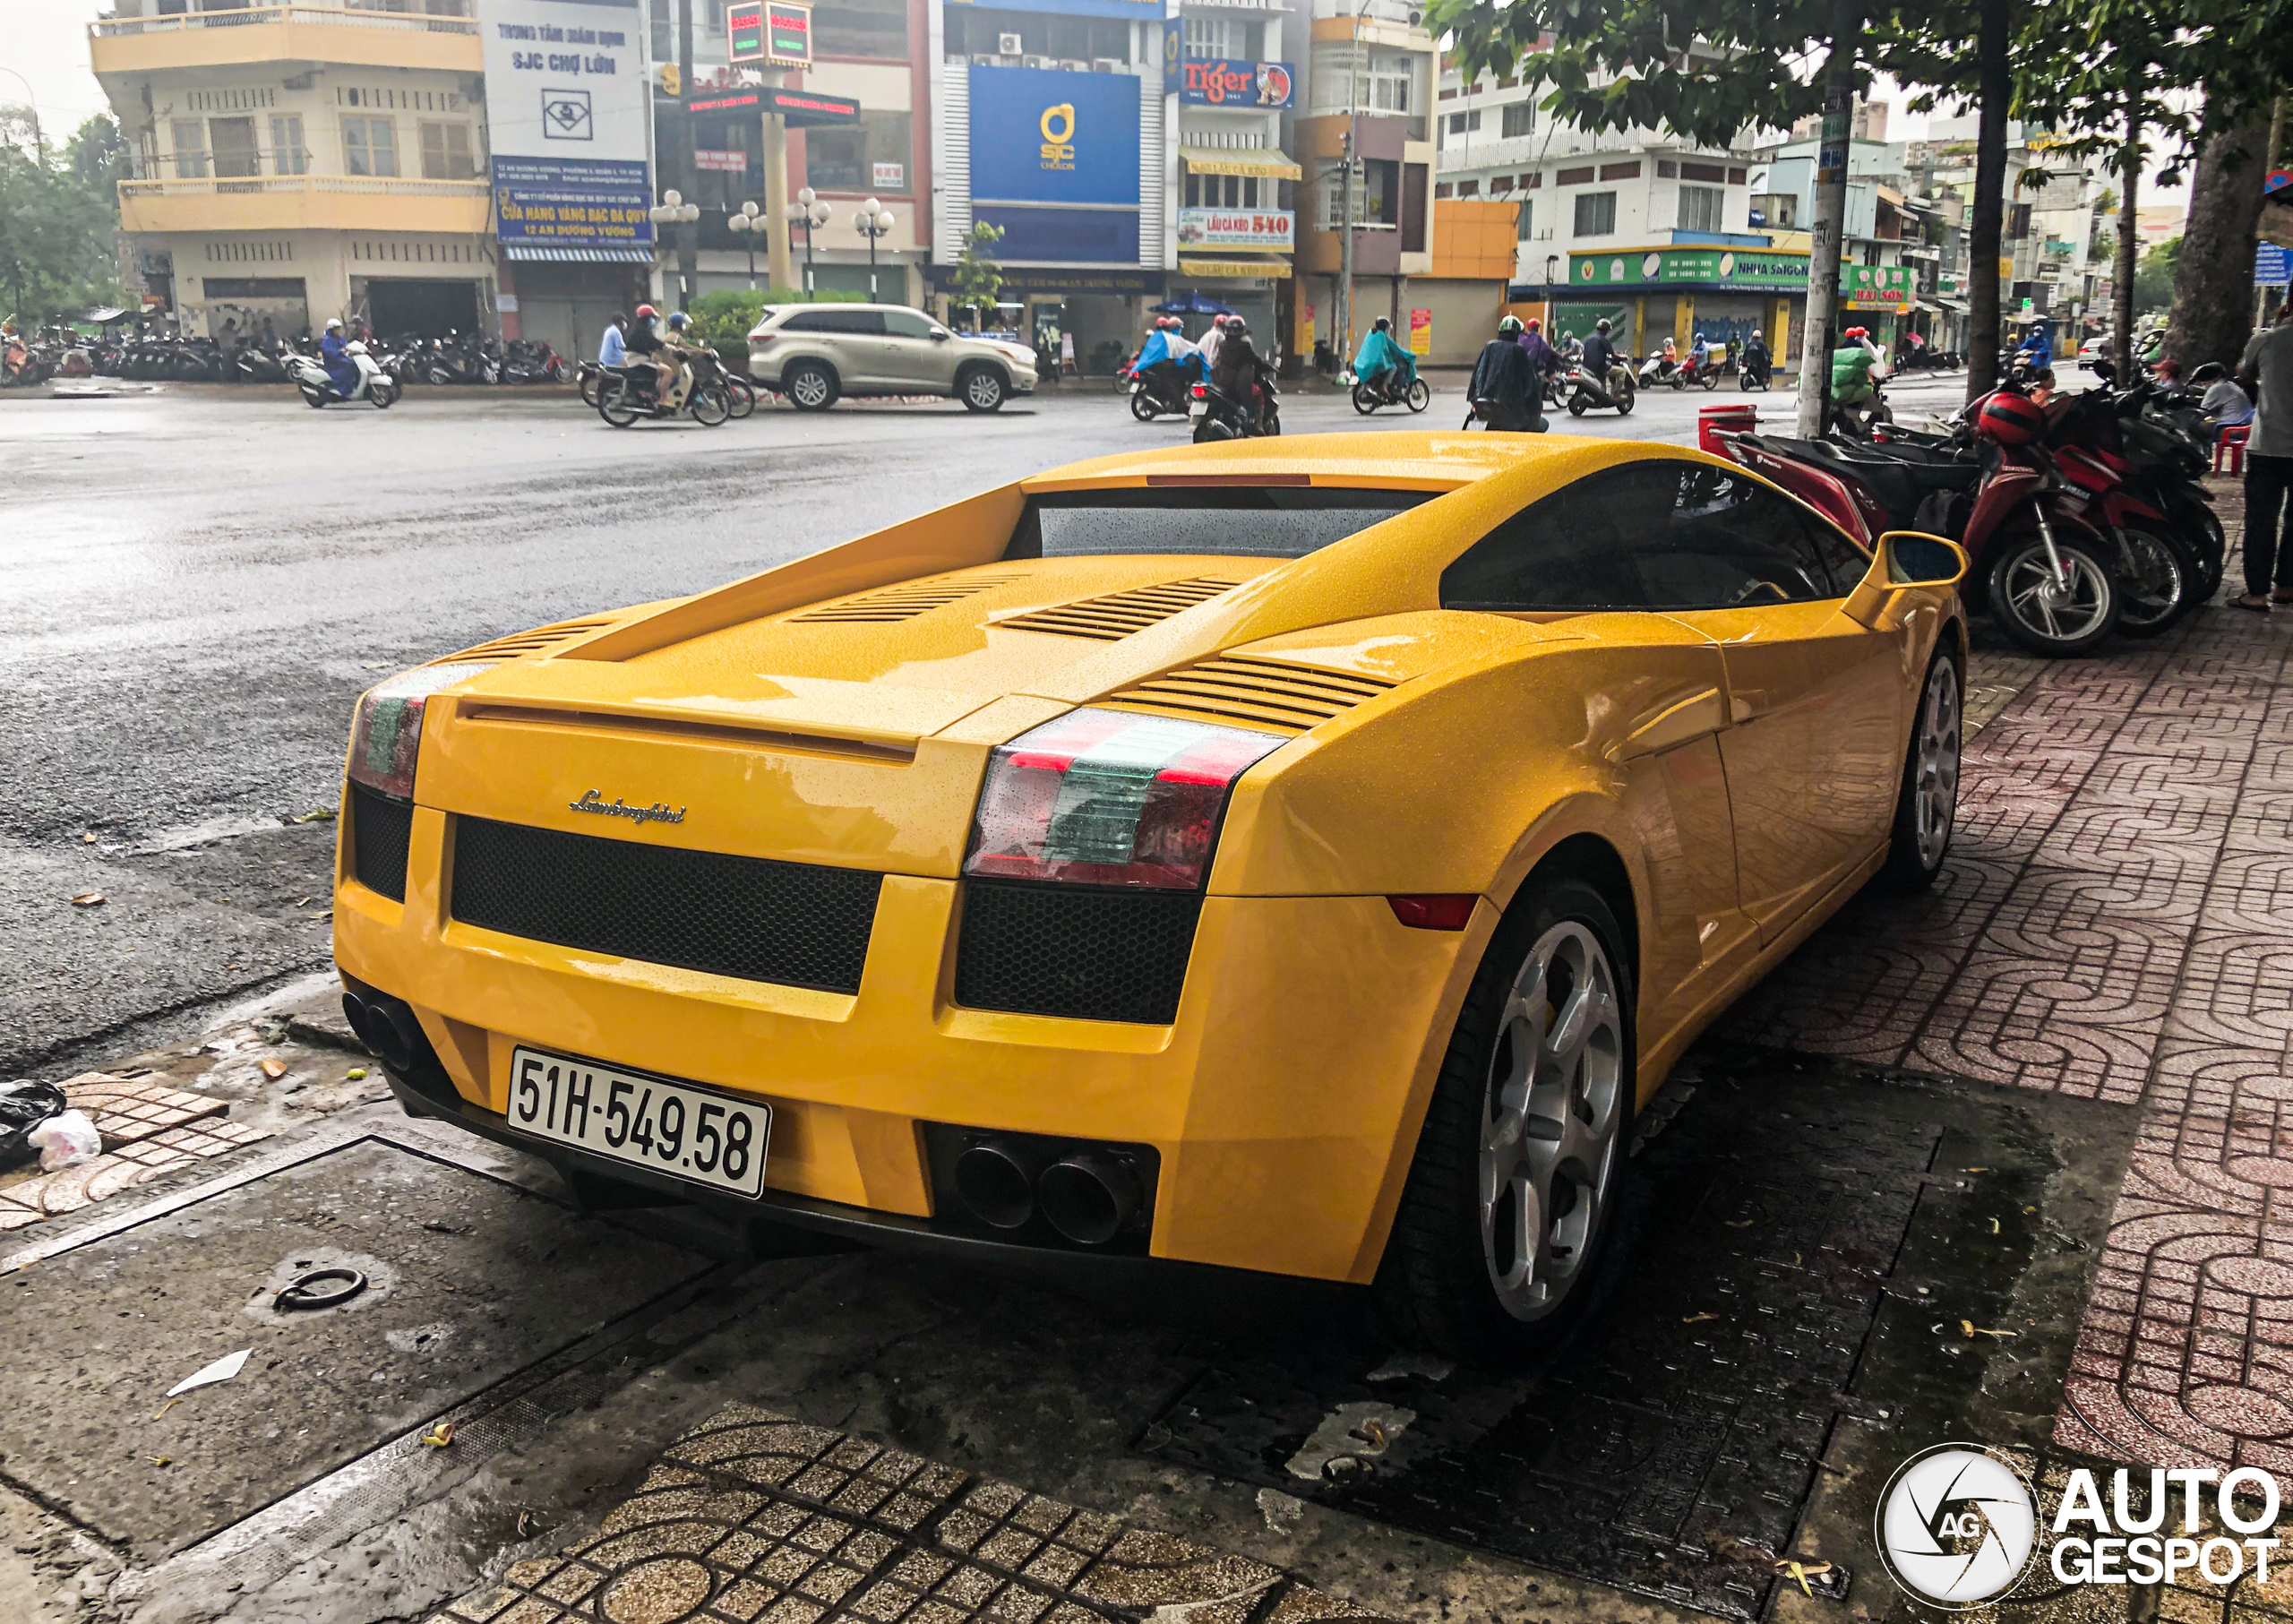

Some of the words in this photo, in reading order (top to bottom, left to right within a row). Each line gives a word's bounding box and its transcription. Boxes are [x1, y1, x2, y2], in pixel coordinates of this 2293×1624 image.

[511, 51, 544, 70] SJC
[1184, 62, 1253, 103] Tiger
[1041, 144, 1075, 162] SJC
[1251, 215, 1289, 234] 540
[569, 788, 687, 825] Lamborghini
[518, 1058, 752, 1181] 51H-549.58
